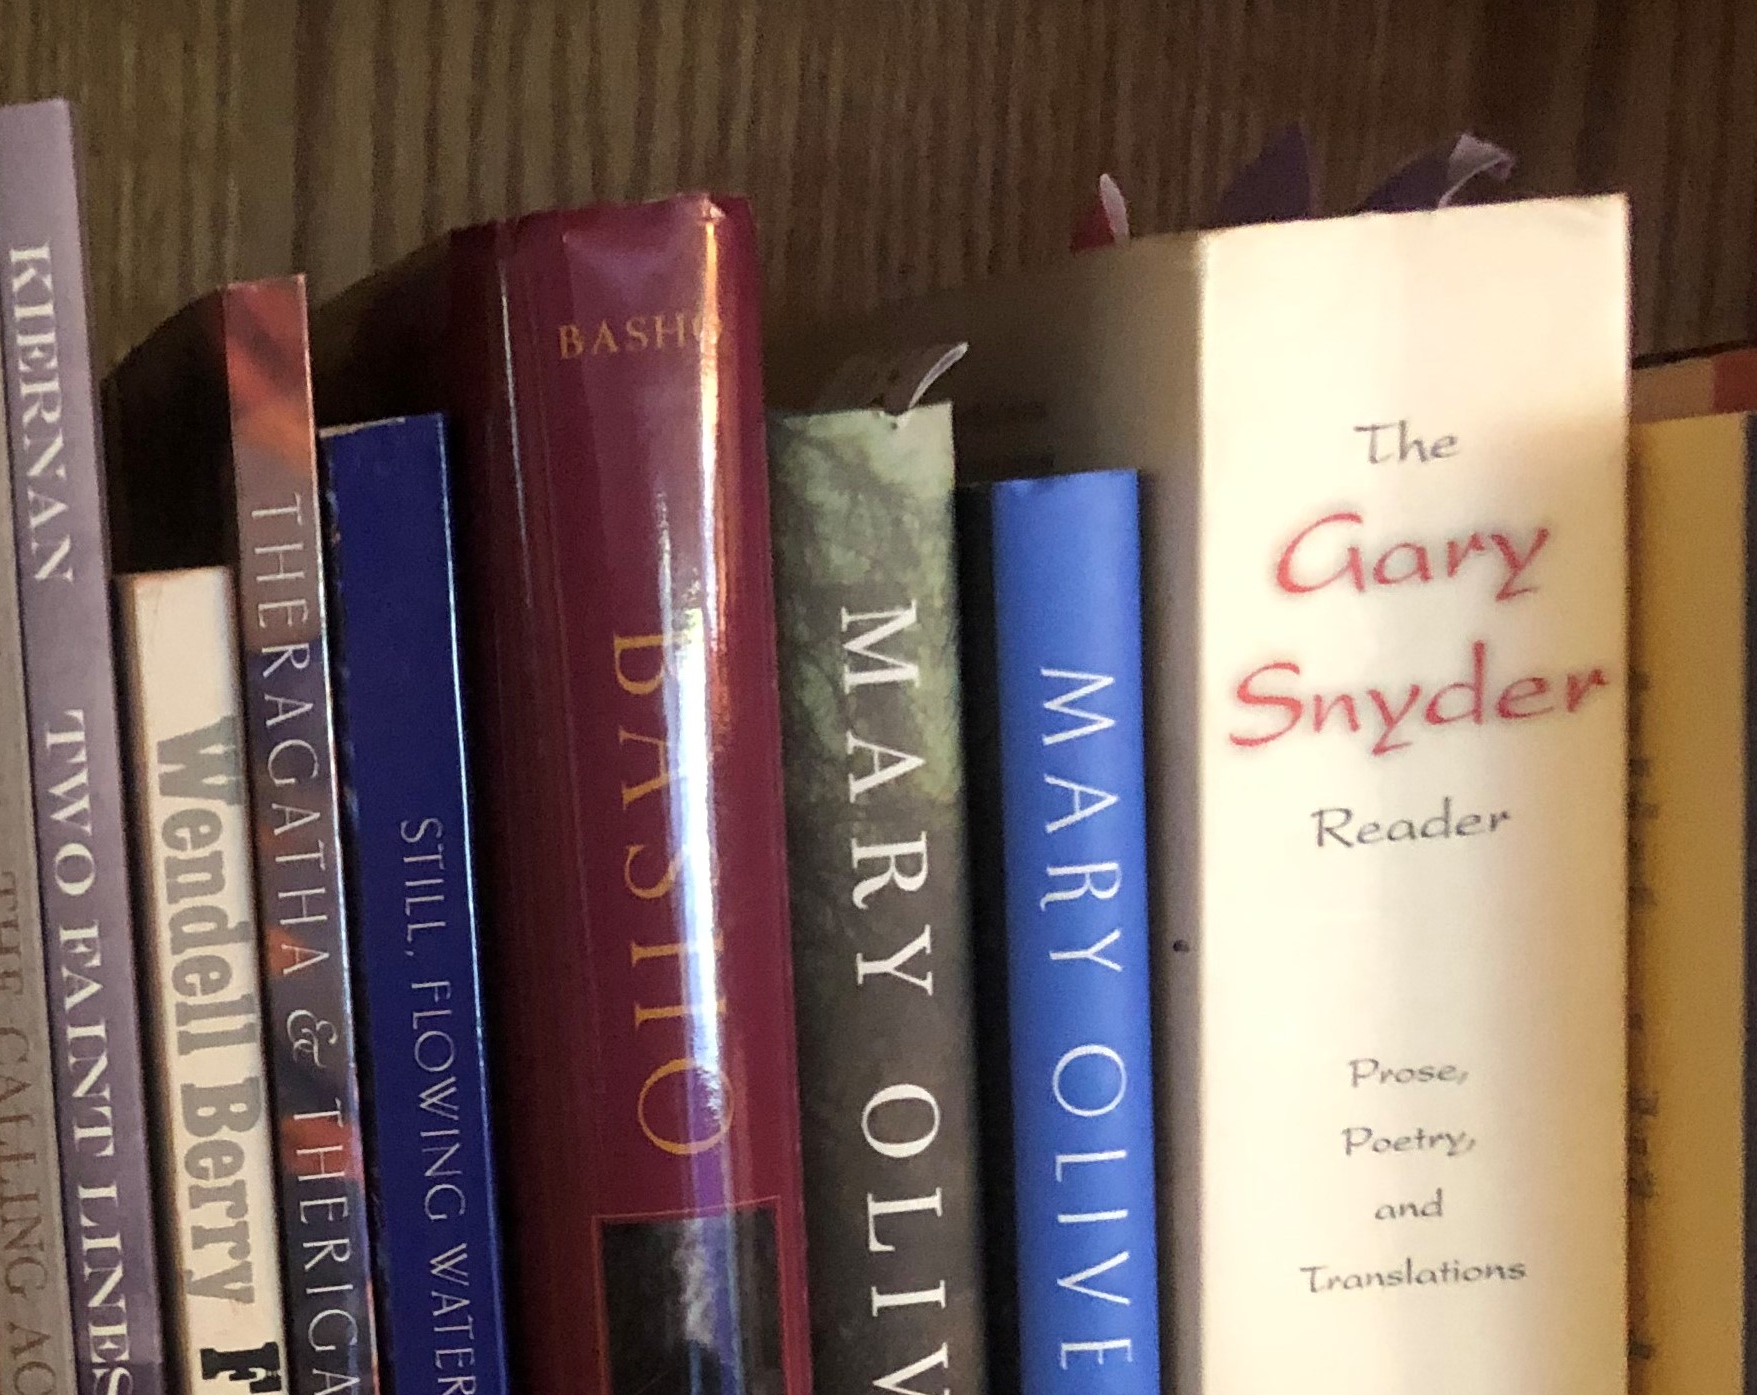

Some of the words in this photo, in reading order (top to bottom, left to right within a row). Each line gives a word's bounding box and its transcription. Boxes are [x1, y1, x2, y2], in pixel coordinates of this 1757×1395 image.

[10, 243, 75, 586] KIERNAN
[1354, 420, 1459, 464] The
[1275, 512, 1550, 601] Gary
[251, 492, 330, 975] THERAGATHA
[1229, 640, 1609, 756] Snyder
[46, 709, 96, 896] TWO
[841, 599, 934, 996] MARY
[1040, 667, 1123, 973] MARY
[1310, 796, 1511, 848] Reader
[157, 713, 260, 1056] Wendell
[399, 817, 446, 958] STILL,
[58, 920, 116, 1157] FAINT
[287, 1009, 338, 1068] &
[410, 979, 467, 1223] FLOWING
[1348, 1058, 1469, 1088] Prose,
[180, 1076, 262, 1305] Berry
[1341, 1127, 1476, 1157] Poetry,
[1374, 1187, 1443, 1220] and
[1300, 1257, 1527, 1293] Translations
